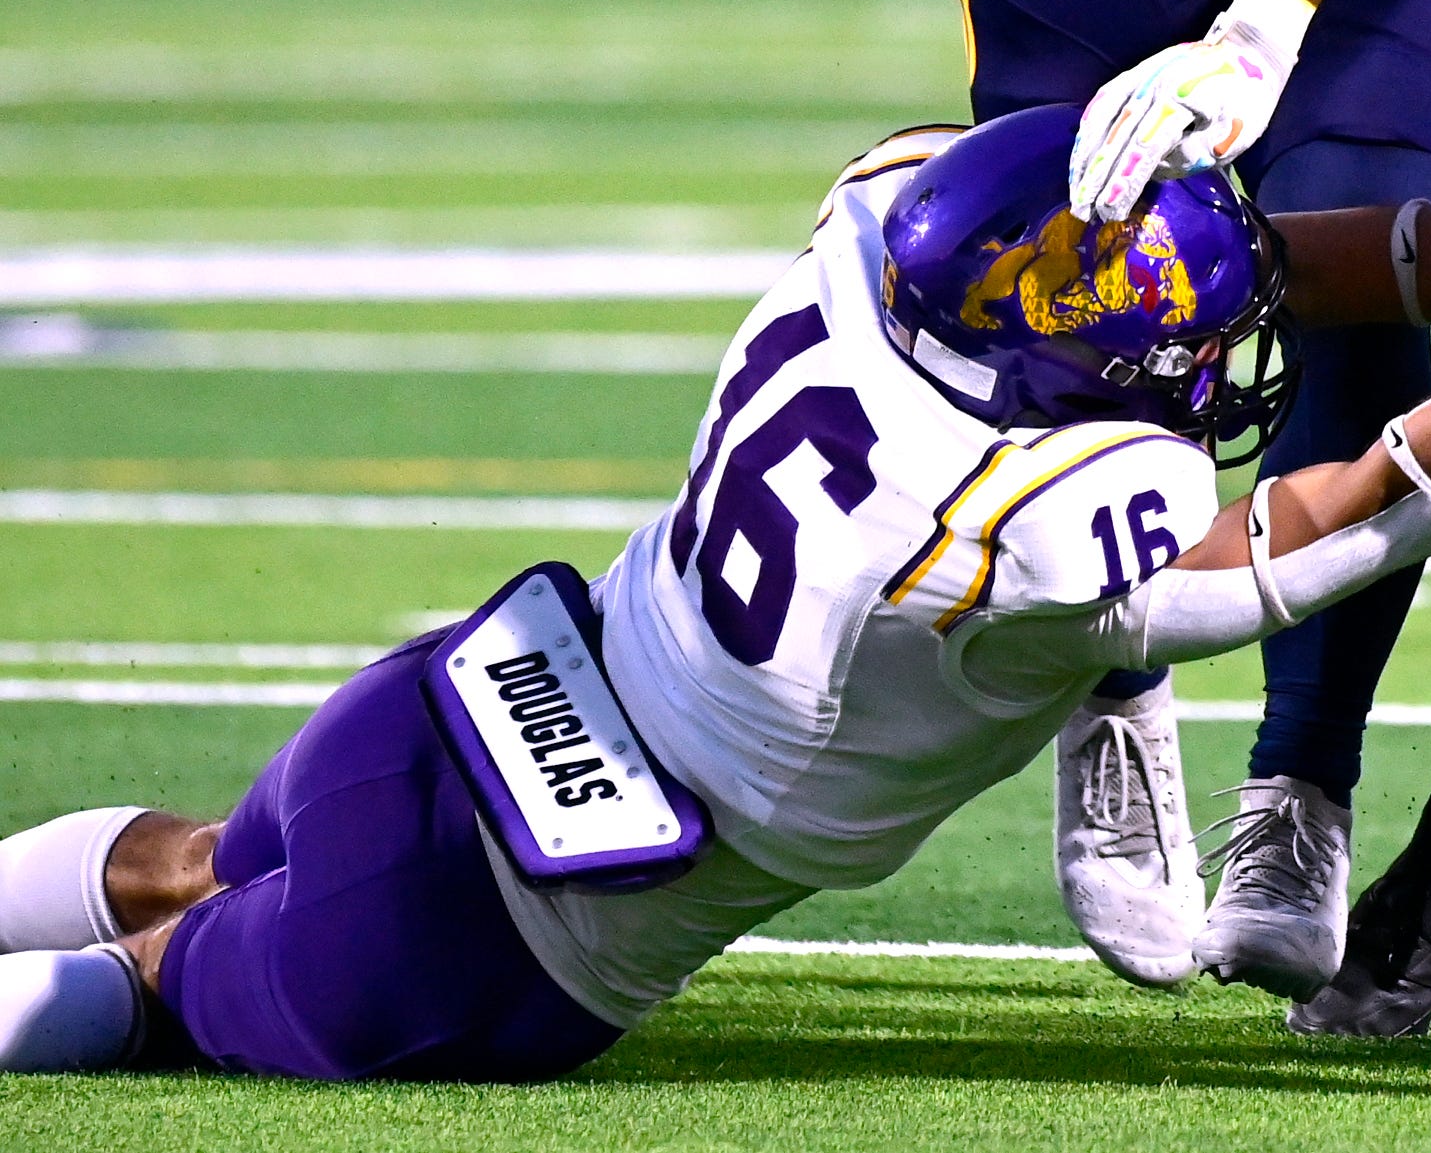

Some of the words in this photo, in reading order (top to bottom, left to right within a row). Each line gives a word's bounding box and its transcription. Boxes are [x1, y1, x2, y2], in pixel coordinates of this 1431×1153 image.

[669, 302, 879, 667] 16
[1091, 489, 1180, 600] 16
[484, 650, 619, 808] DOUGLAS
